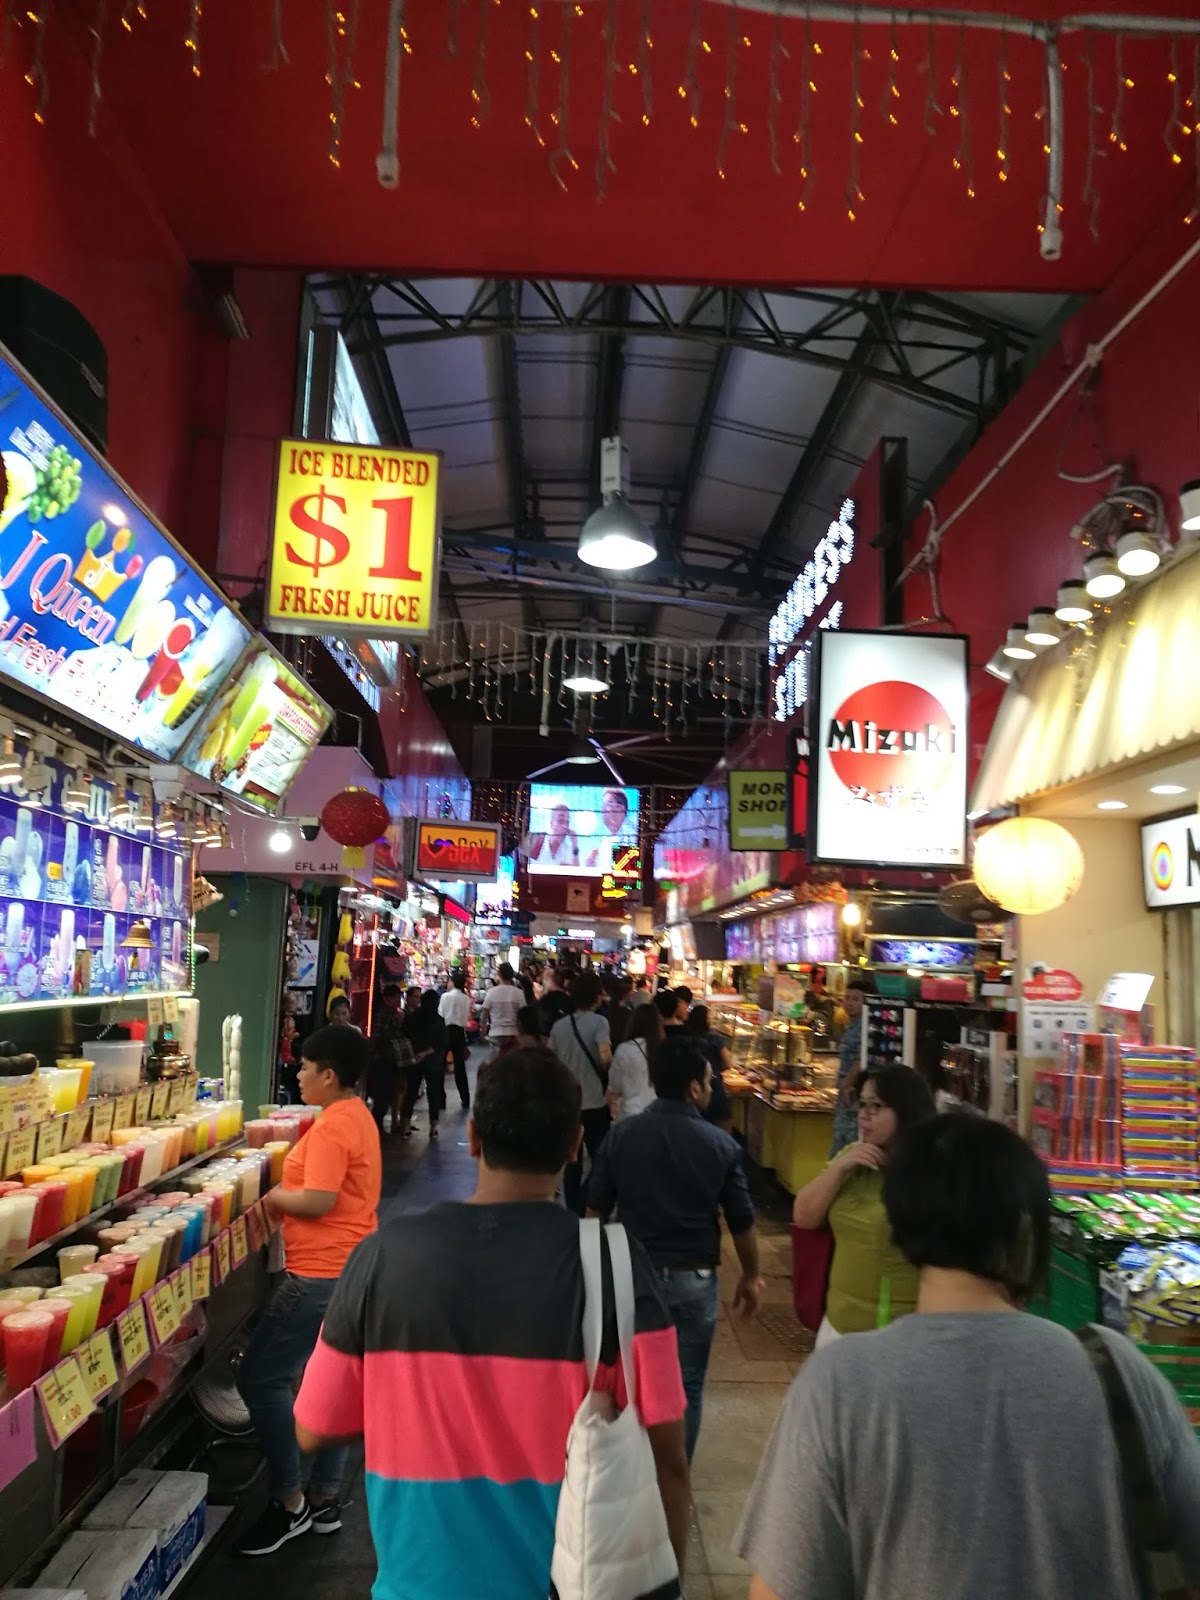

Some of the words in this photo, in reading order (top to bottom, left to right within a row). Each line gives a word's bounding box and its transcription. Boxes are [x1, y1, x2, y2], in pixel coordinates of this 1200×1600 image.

[288, 449, 324, 476] ICE
[331, 452, 429, 486] BLENDED
[29, 552, 117, 647] Queen
[279, 584, 350, 617] FRESH
[356, 592, 420, 622] JUICE
[11, 621, 68, 677] Fresh
[826, 718, 957, 755] Mizuki
[295, 861, 316, 871] EFL
[319, 862, 338, 872] 4-H
